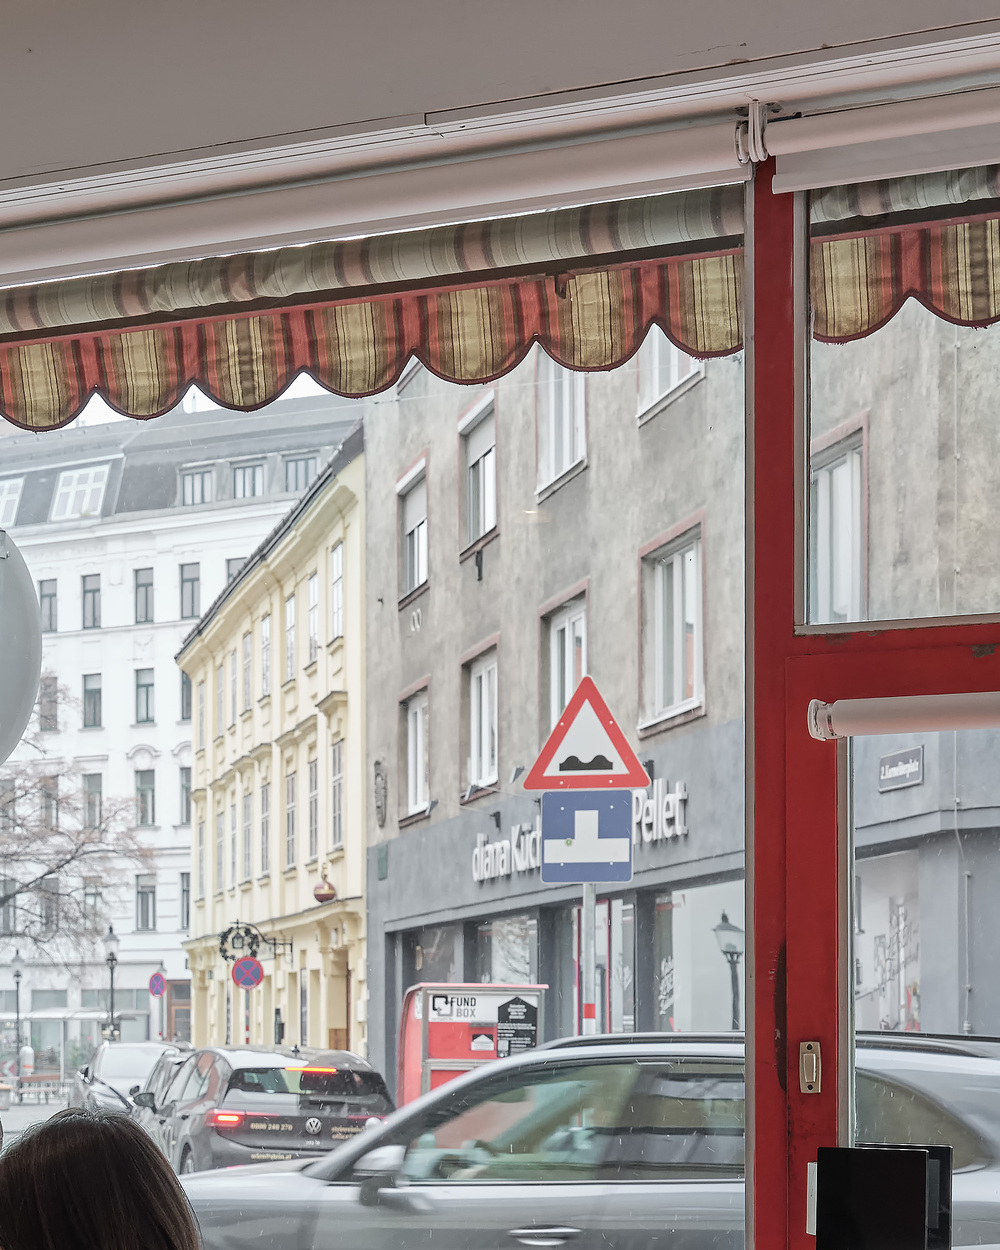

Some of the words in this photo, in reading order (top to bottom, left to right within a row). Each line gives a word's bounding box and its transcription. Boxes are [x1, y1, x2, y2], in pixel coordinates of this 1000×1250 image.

[632, 778, 688, 845] Pellet
[450, 997, 477, 1007] FUND
[456, 1008, 476, 1018] BOX
